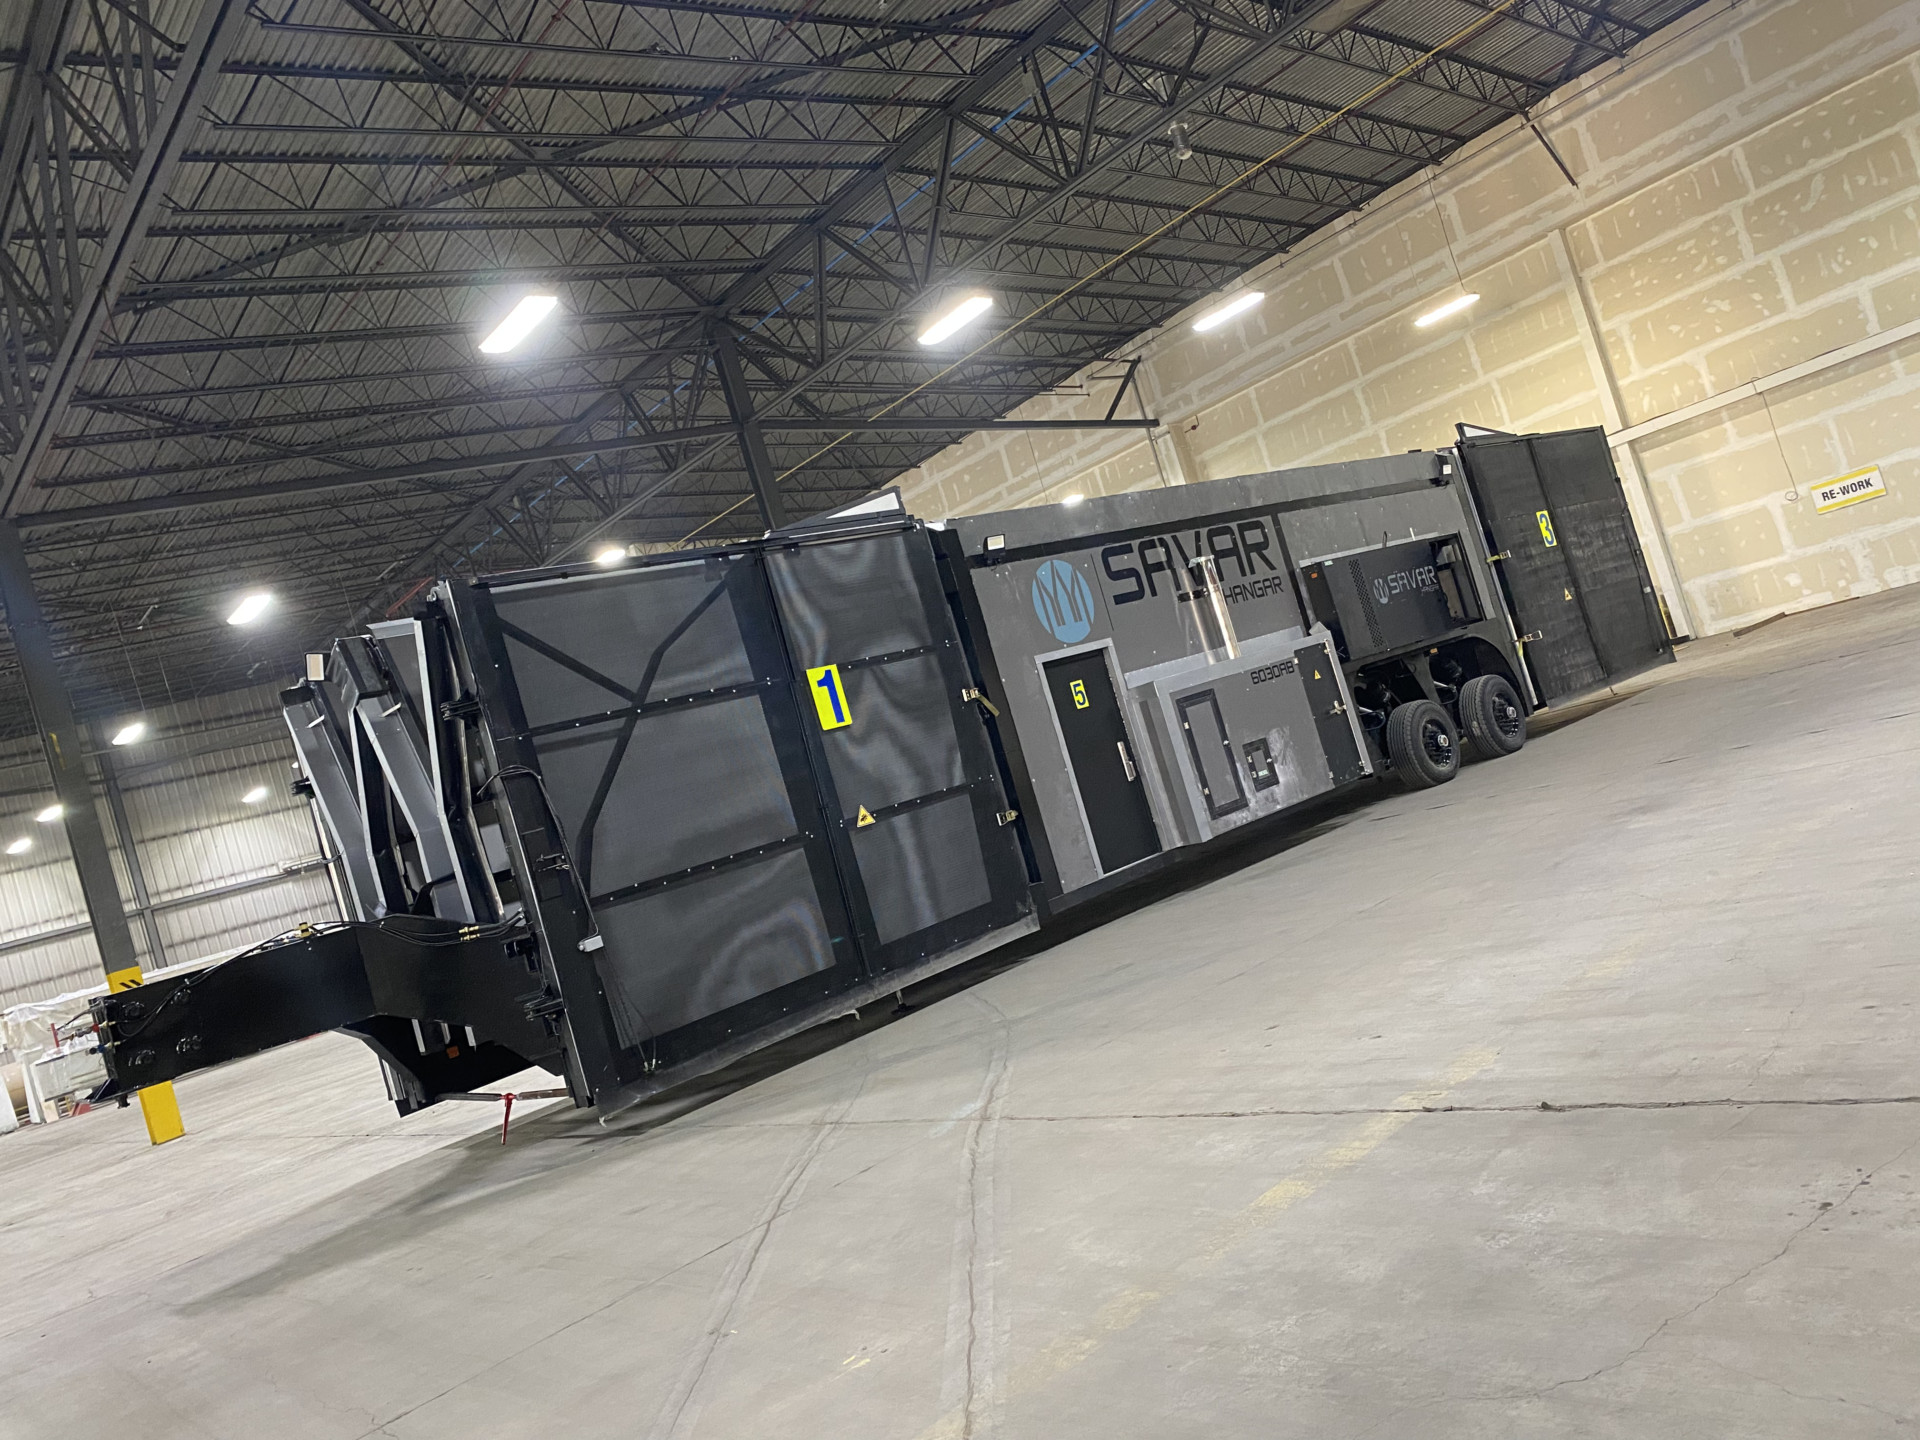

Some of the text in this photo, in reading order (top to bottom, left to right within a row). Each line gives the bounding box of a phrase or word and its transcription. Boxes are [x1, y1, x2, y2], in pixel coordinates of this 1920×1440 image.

[1821, 478, 1873, 501] RE-WORK
[1539, 513, 1554, 545] 3
[1101, 520, 1277, 605] SAVAR
[1223, 575, 1284, 605] HANGAR
[1387, 565, 1437, 594] SAVAR
[1250, 660, 1295, 685] 6030AB
[816, 669, 846, 723] 1
[1073, 683, 1086, 706] 5
